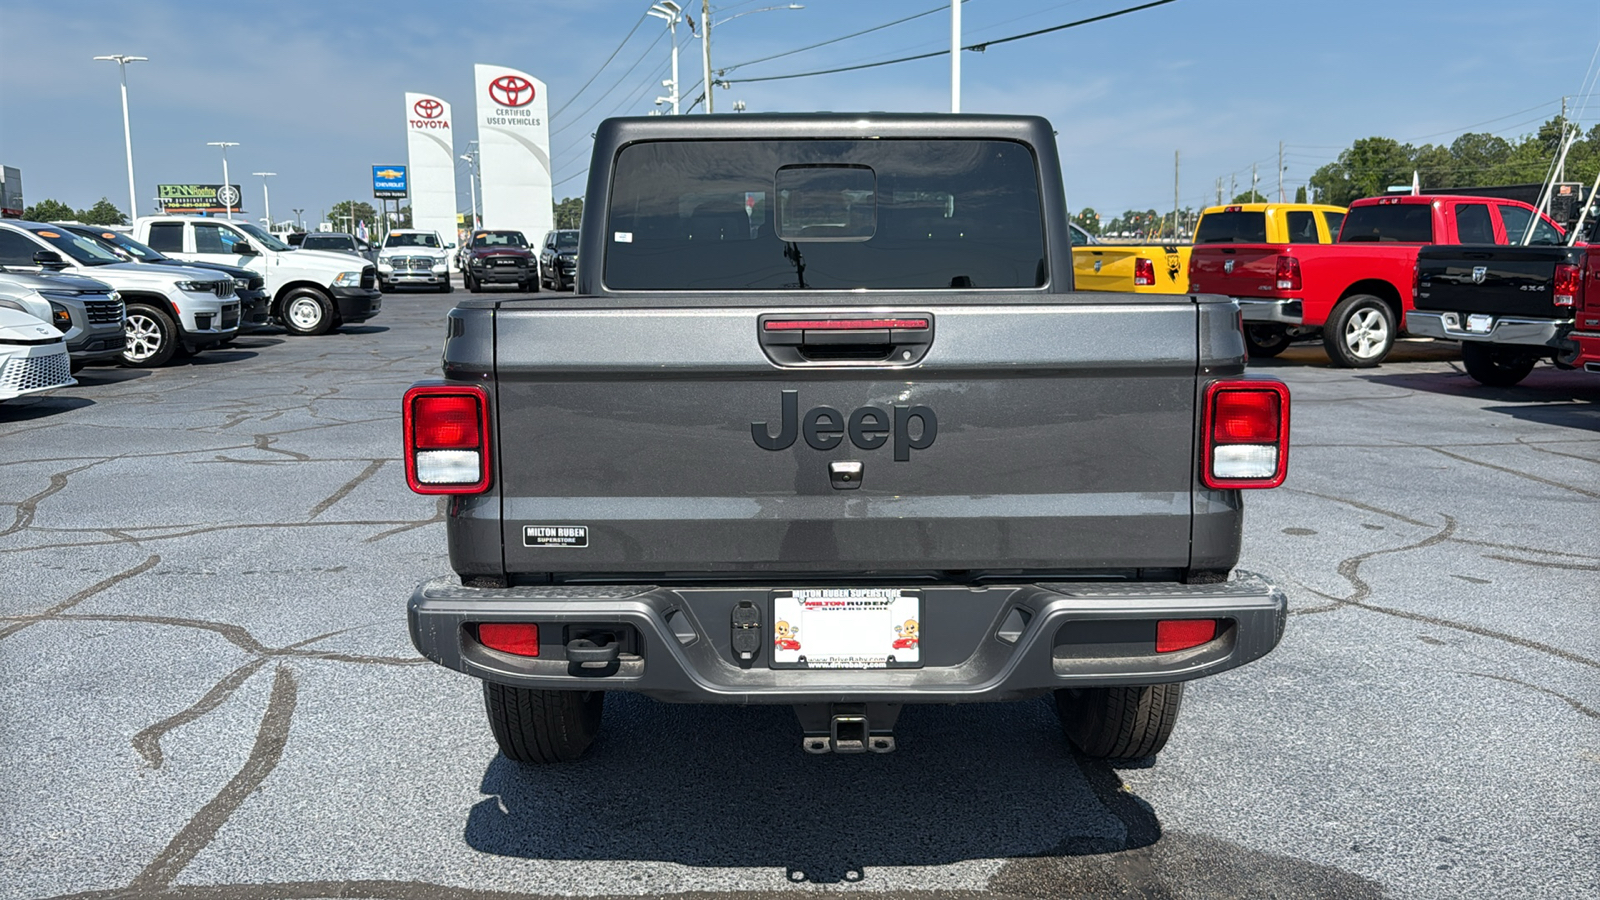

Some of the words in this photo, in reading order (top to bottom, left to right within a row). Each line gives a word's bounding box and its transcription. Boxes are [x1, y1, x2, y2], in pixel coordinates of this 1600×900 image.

[496, 108, 531, 116] CERTIFIED
[410, 120, 449, 129] TOYOTA
[487, 117, 506, 125] USED
[507, 118, 540, 126] VEHICLES
[750, 389, 938, 462] Jeep
[527, 528, 556, 537] MILTON
[558, 528, 585, 537] RUBEN
[792, 589, 822, 598] MILTON
[823, 589, 849, 598] RUBEN
[850, 589, 901, 598] SUPERSTORE
